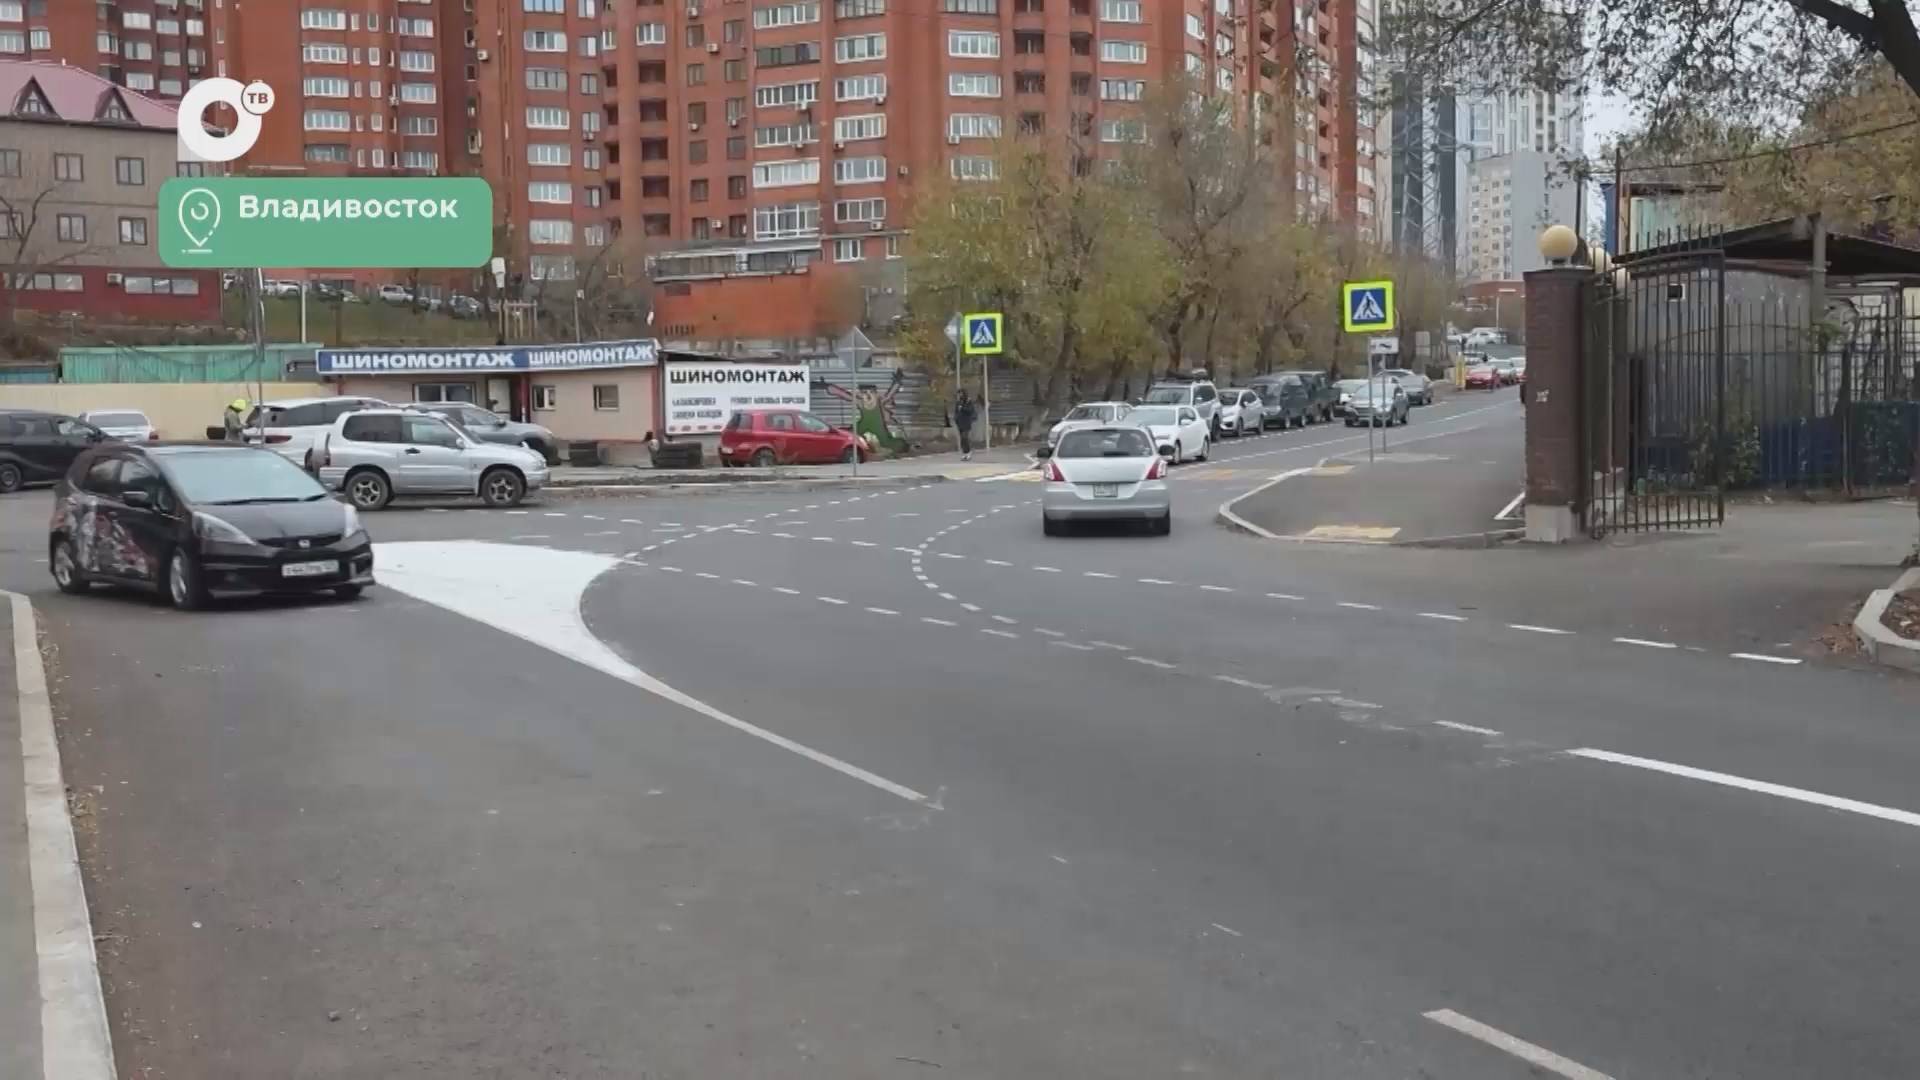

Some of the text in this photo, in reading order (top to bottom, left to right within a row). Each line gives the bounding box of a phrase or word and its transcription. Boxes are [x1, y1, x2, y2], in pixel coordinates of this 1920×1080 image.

[331, 352, 515, 369] ШИНОМОНТАЖ
[529, 344, 654, 365] ШИНОМОНТАЖ
[670, 369, 806, 384] ШИНОМОНТАЖ
